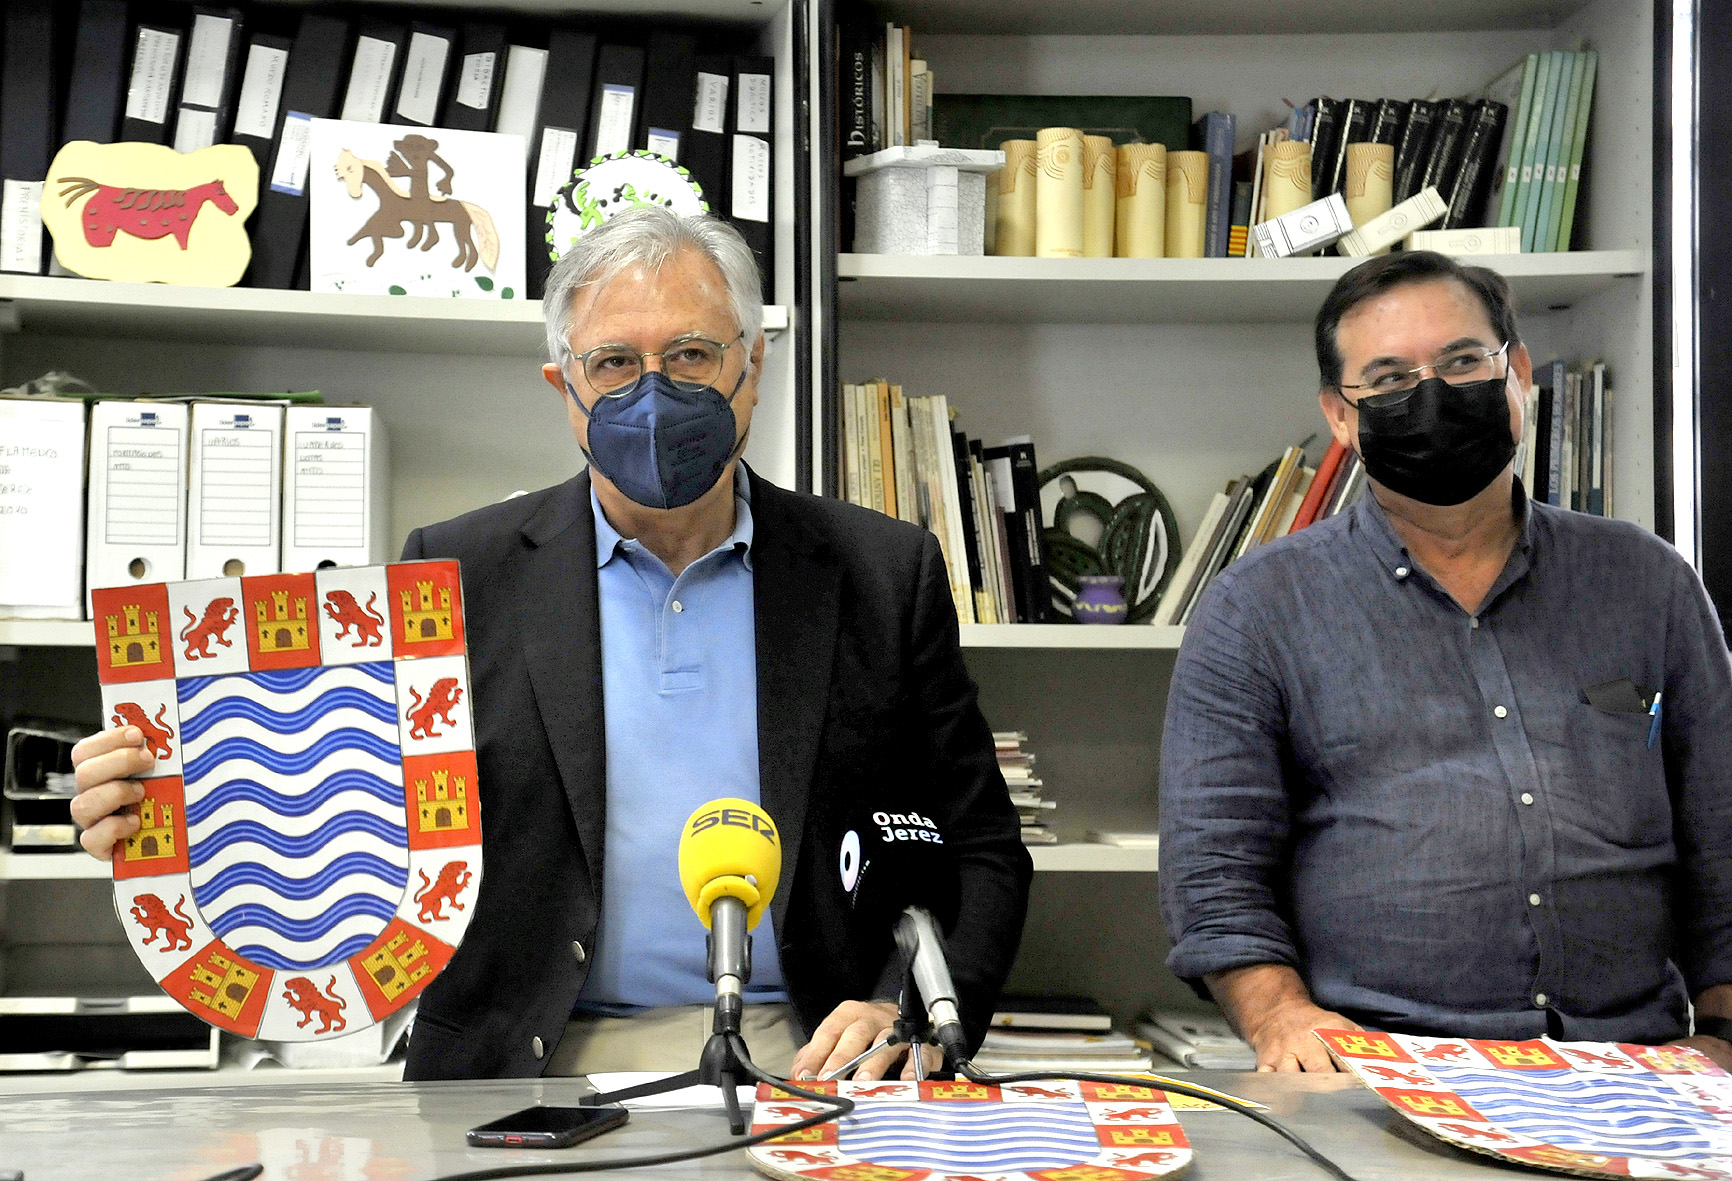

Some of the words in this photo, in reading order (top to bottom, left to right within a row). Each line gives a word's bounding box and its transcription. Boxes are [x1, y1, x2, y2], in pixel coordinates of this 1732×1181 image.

[706, 80, 717, 121] VARIOS
[691, 808, 776, 846] SER
[873, 811, 938, 829] Onda
[881, 826, 944, 844] Jerez
